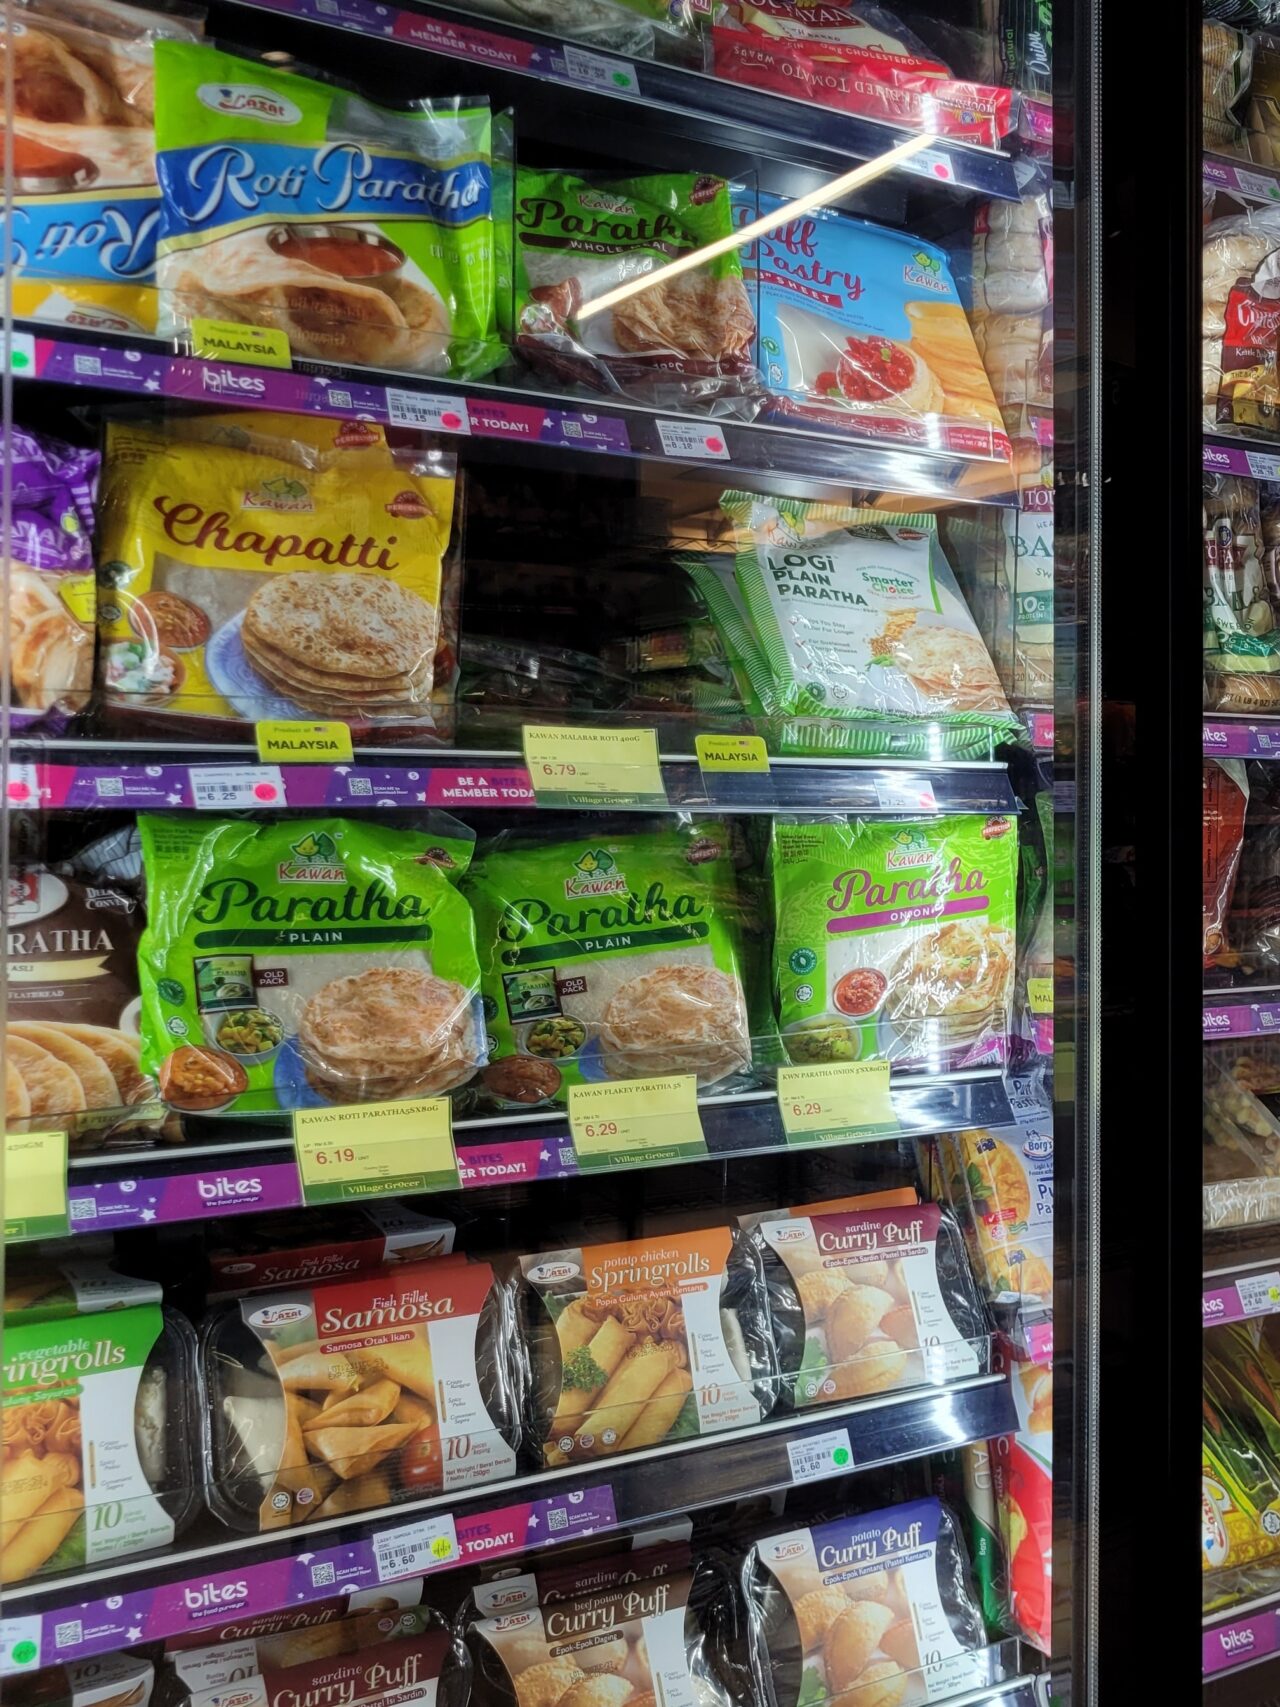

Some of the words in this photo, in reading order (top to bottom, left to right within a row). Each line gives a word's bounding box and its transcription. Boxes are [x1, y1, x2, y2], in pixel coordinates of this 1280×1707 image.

[427, 24, 444, 34] BE
[410, 29, 468, 50] MEMBER
[471, 44, 517, 64] TODAY!
[846, 47, 922, 66] CHOLESTEROL
[781, 63, 850, 93] TOMATO
[188, 143, 308, 222] Roti
[314, 141, 483, 212] Paratha
[579, 194, 635, 216] Kawan
[570, 240, 623, 253] WHOLE
[740, 239, 865, 300] Pastry
[903, 265, 951, 293] Kawan
[775, 276, 832, 303] SHEET
[203, 336, 278, 357] MALAYSIA
[202, 367, 266, 393] bites
[483, 418, 530, 432] TODAY!
[242, 491, 315, 512] Kawan
[153, 495, 400, 572] Chapatti
[773, 569, 832, 587] PLAIN
[862, 571, 914, 588] Smarter
[777, 583, 869, 607] PARATHA
[872, 582, 914, 596] Choice
[267, 739, 339, 750] MALAYSIA
[529, 732, 559, 741] KAWAN
[561, 734, 599, 742] MALABAR
[704, 751, 759, 763] MALAYSIA
[543, 763, 577, 777] 6.79
[458, 777, 473, 786] BE
[478, 777, 488, 786] A
[207, 792, 237, 801] 6.25
[443, 788, 496, 799] MEMBER
[887, 851, 935, 869] Kawan
[279, 864, 347, 882] Kawan
[565, 875, 627, 896] Kawan
[827, 857, 989, 912] Paratha
[194, 877, 431, 924] Paratha
[502, 882, 704, 942] Paratha
[890, 906, 931, 922] ONION
[290, 931, 343, 943] PLAIN
[586, 936, 632, 951] PLAIN
[260, 977, 286, 985] PACK
[562, 986, 585, 994] PACK
[566, 979, 583, 987] OLD
[800, 1070, 832, 1079] PARATHA
[833, 1068, 856, 1076] ONION
[574, 1089, 603, 1100] KAWAN
[604, 1087, 634, 1097] FLAKEY
[635, 1084, 673, 1095] PARATHA
[301, 1113, 336, 1125] KAWAN
[339, 1111, 361, 1121] ROTI
[792, 1102, 822, 1117] 6.29
[585, 1121, 619, 1138] 6.29
[316, 1148, 356, 1165] 6.19
[614, 1154, 645, 1165] Village
[479, 1162, 527, 1176] TODAY!
[199, 1177, 262, 1199] bites
[347, 1183, 382, 1194] Village
[819, 1230, 878, 1252] Curry
[883, 1220, 924, 1247] Puff
[845, 1221, 881, 1234] sardine
[260, 1257, 361, 1282] Samosa
[604, 1256, 638, 1270] potato
[640, 1249, 680, 1263] chicken
[825, 1255, 859, 1267] Epok-Epok
[859, 1253, 879, 1264] Sardin
[590, 1253, 710, 1292] Springrolls
[373, 1295, 397, 1309] Fish
[400, 1290, 428, 1304] Fillet
[596, 1295, 618, 1307] Popia
[618, 1293, 648, 1305] Gulung
[650, 1289, 673, 1301] Ayam
[673, 1284, 704, 1297] Kentang
[320, 1297, 454, 1333] Samosa
[18, 1338, 90, 1362] vegetable
[326, 1340, 363, 1353] Samosa
[364, 1335, 389, 1347] Otak
[391, 1331, 411, 1343] Ikan
[7, 1341, 127, 1384] ingrolls
[700, 1383, 722, 1406] 10
[446, 1434, 471, 1462] 10
[800, 1461, 821, 1472] 6.60
[92, 1503, 123, 1532] 10
[466, 1532, 514, 1552] TODAY!
[820, 1541, 877, 1567] Curry
[882, 1522, 922, 1550] Puff
[851, 1528, 881, 1545] potato
[389, 1554, 415, 1568] 6.60
[824, 1571, 859, 1586] Epok-Epok
[860, 1563, 884, 1577] Kentang
[905, 1549, 932, 1566] Kentang)
[575, 1571, 619, 1589] sardine
[185, 1580, 249, 1609] bites
[575, 1599, 594, 1612] beef
[595, 1591, 623, 1608] potato
[547, 1607, 615, 1637] Curry
[622, 1584, 670, 1616] Puff
[220, 1615, 288, 1640] Curry
[290, 1607, 337, 1628] Puff
[556, 1640, 594, 1655] Epok-Epok
[594, 1632, 618, 1648] Daging
[1220, 1628, 1255, 1651] bites
[273, 1677, 356, 1707] Curry
[365, 1653, 423, 1692] Puff
[312, 1665, 363, 1687] sardine
[397, 1688, 427, 1703] Sardin)
